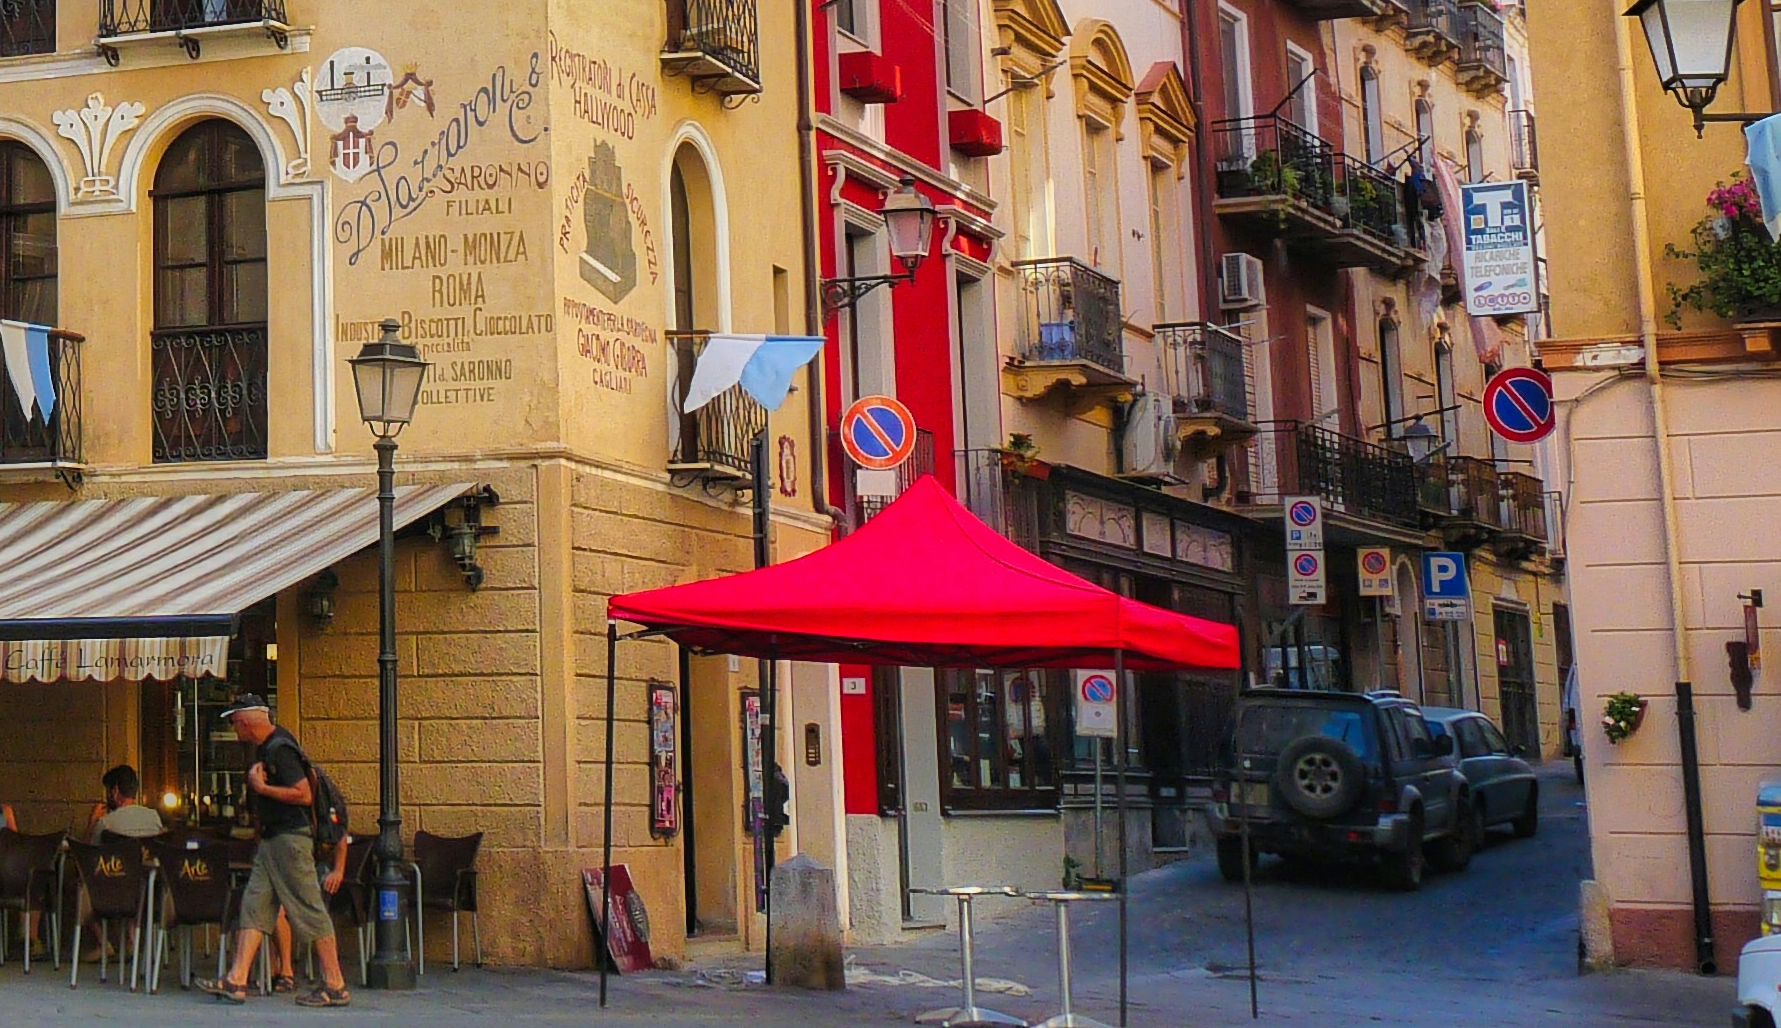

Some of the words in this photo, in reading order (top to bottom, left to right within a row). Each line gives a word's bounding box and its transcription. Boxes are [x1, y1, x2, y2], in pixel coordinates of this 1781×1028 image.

[549, 29, 613, 99] REGISTRATORI
[616, 67, 625, 99] di
[628, 72, 658, 120] CASSA
[437, 160, 550, 194] SARONNO
[445, 197, 513, 217] FILIALI
[380, 234, 448, 272] MILANO
[462, 230, 529, 267] MONZA
[1469, 231, 1523, 245] TABACCHI
[431, 271, 487, 309] ROMA
[472, 306, 554, 338] CIOCCOLATO
[451, 358, 512, 384] SARONNO
[418, 385, 496, 406] OLLETTIVE
[1430, 556, 1458, 593] P
[76, 646, 214, 670] Lamarmora
